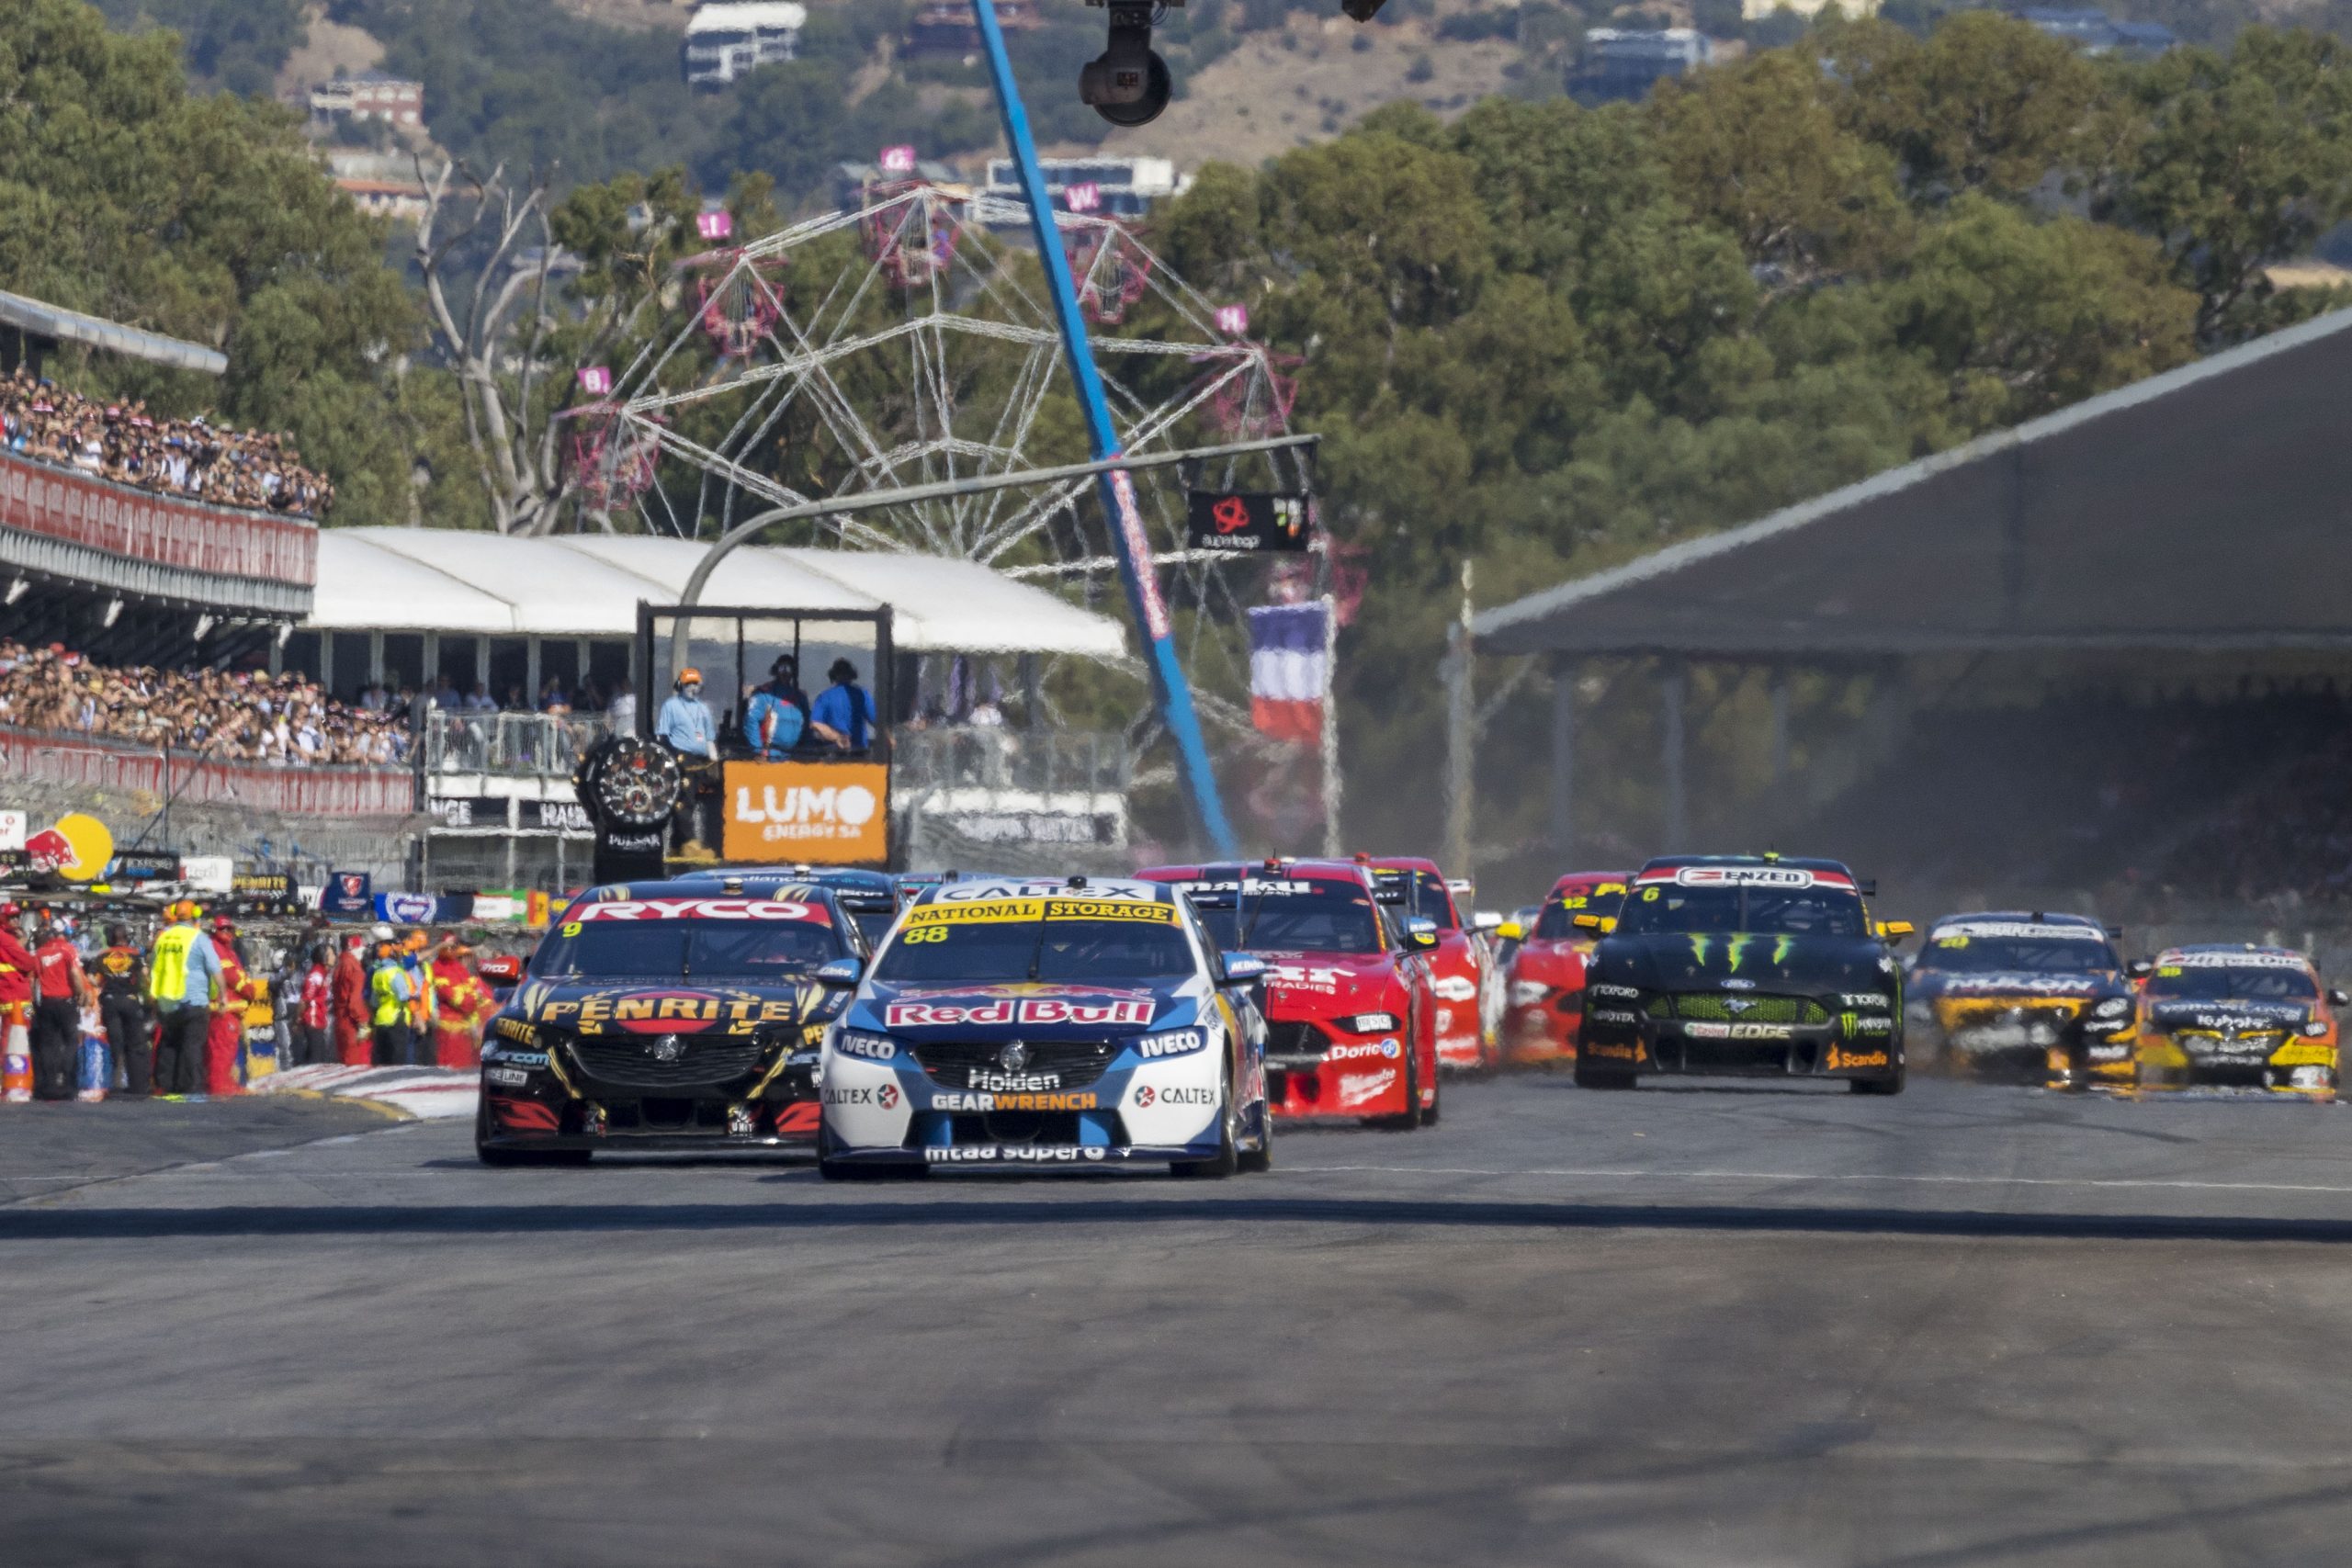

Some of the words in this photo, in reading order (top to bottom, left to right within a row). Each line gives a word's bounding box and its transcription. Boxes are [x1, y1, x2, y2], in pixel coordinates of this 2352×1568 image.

[1724, 871, 1801, 883] ENZED
[944, 886, 1145, 900] CALTEX
[1642, 886, 1660, 902] 6
[579, 901, 809, 920] RYCO
[1562, 896, 1588, 909] 12
[910, 901, 1037, 924] NATIONAL
[1049, 901, 1169, 919] STORAGE
[561, 921, 582, 938] 9
[904, 926, 949, 945] 88
[541, 998, 794, 1021] PENRITE
[886, 1000, 1014, 1026] Red
[1018, 999, 1156, 1025] Bull
[1730, 1024, 1793, 1040] EDGE
[840, 1034, 896, 1060] IVECO
[1140, 1032, 1202, 1059] IVECO
[1841, 1051, 1887, 1067] Scandia
[932, 1093, 1097, 1111] GEARWRENCH
[1160, 1088, 1217, 1105] CALTEX
